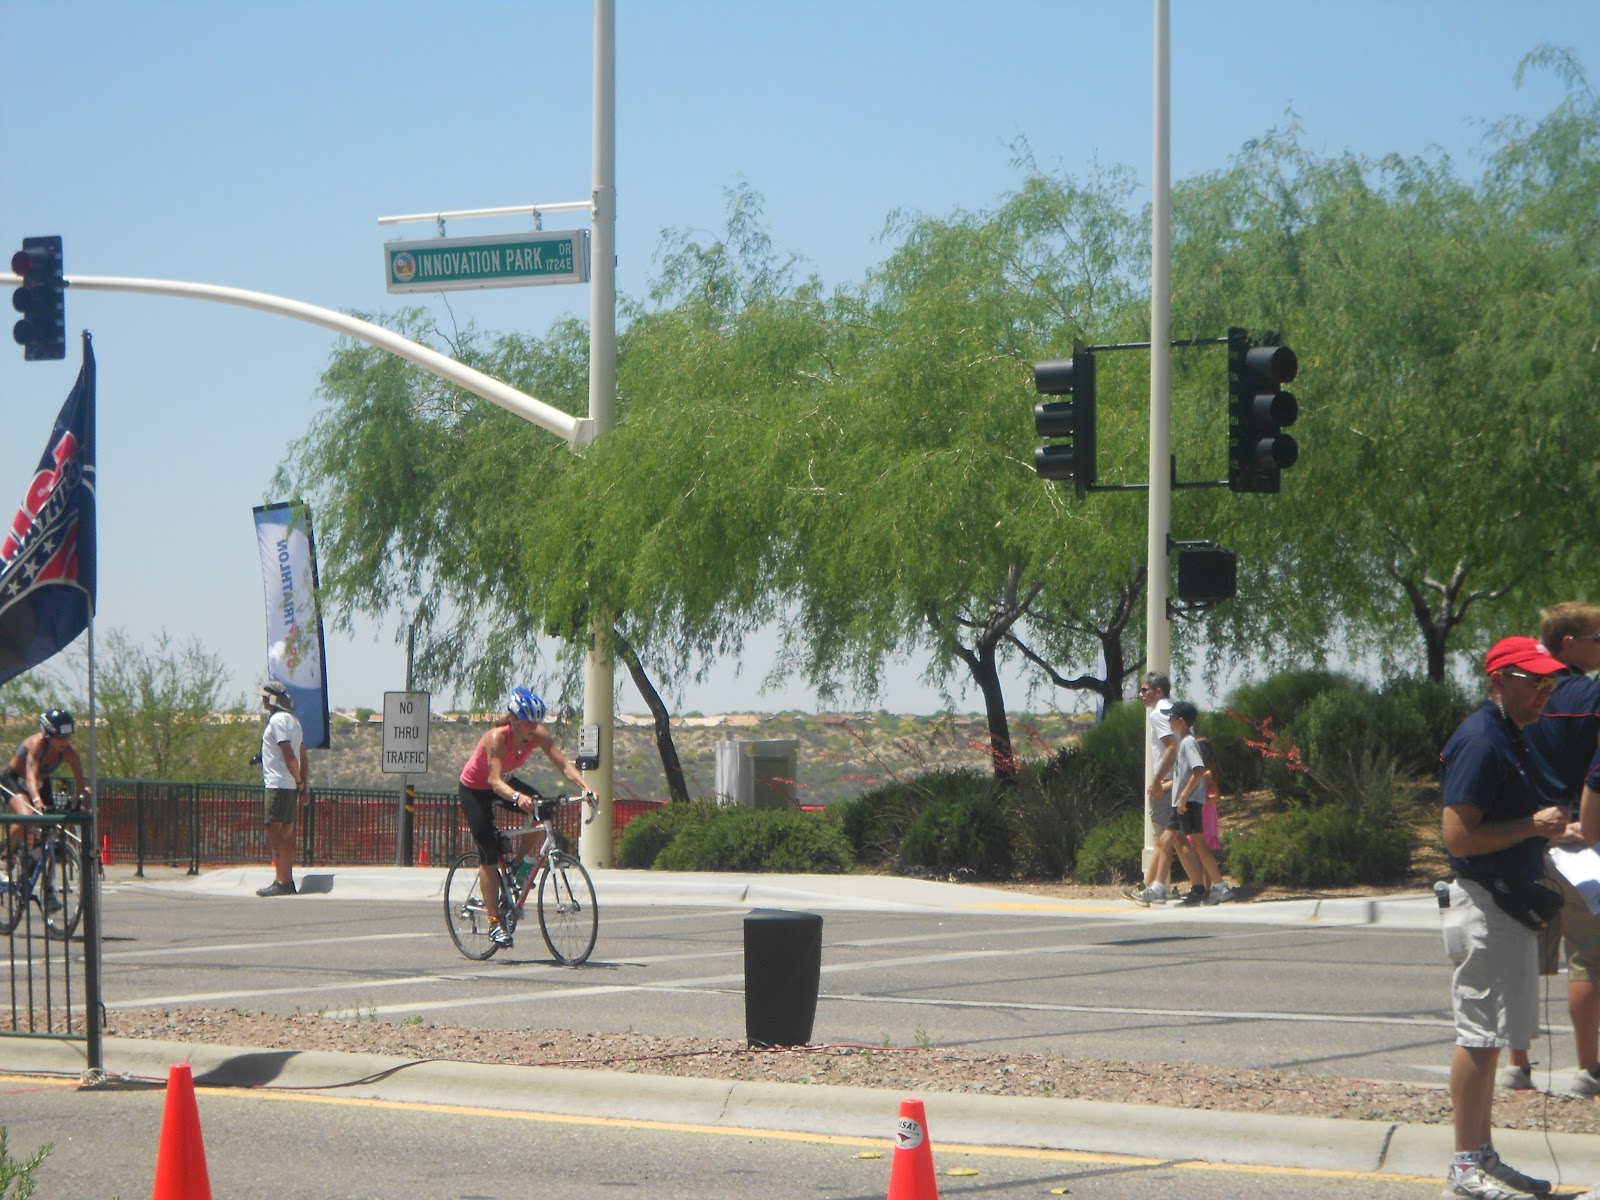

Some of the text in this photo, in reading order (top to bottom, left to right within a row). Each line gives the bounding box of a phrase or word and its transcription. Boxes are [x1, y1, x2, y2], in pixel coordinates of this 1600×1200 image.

[418, 243, 572, 277] INNOVATION PARK DR
[399, 701, 414, 715] NO
[393, 726, 419, 740] THRU
[385, 751, 425, 764] TRAFFIC
